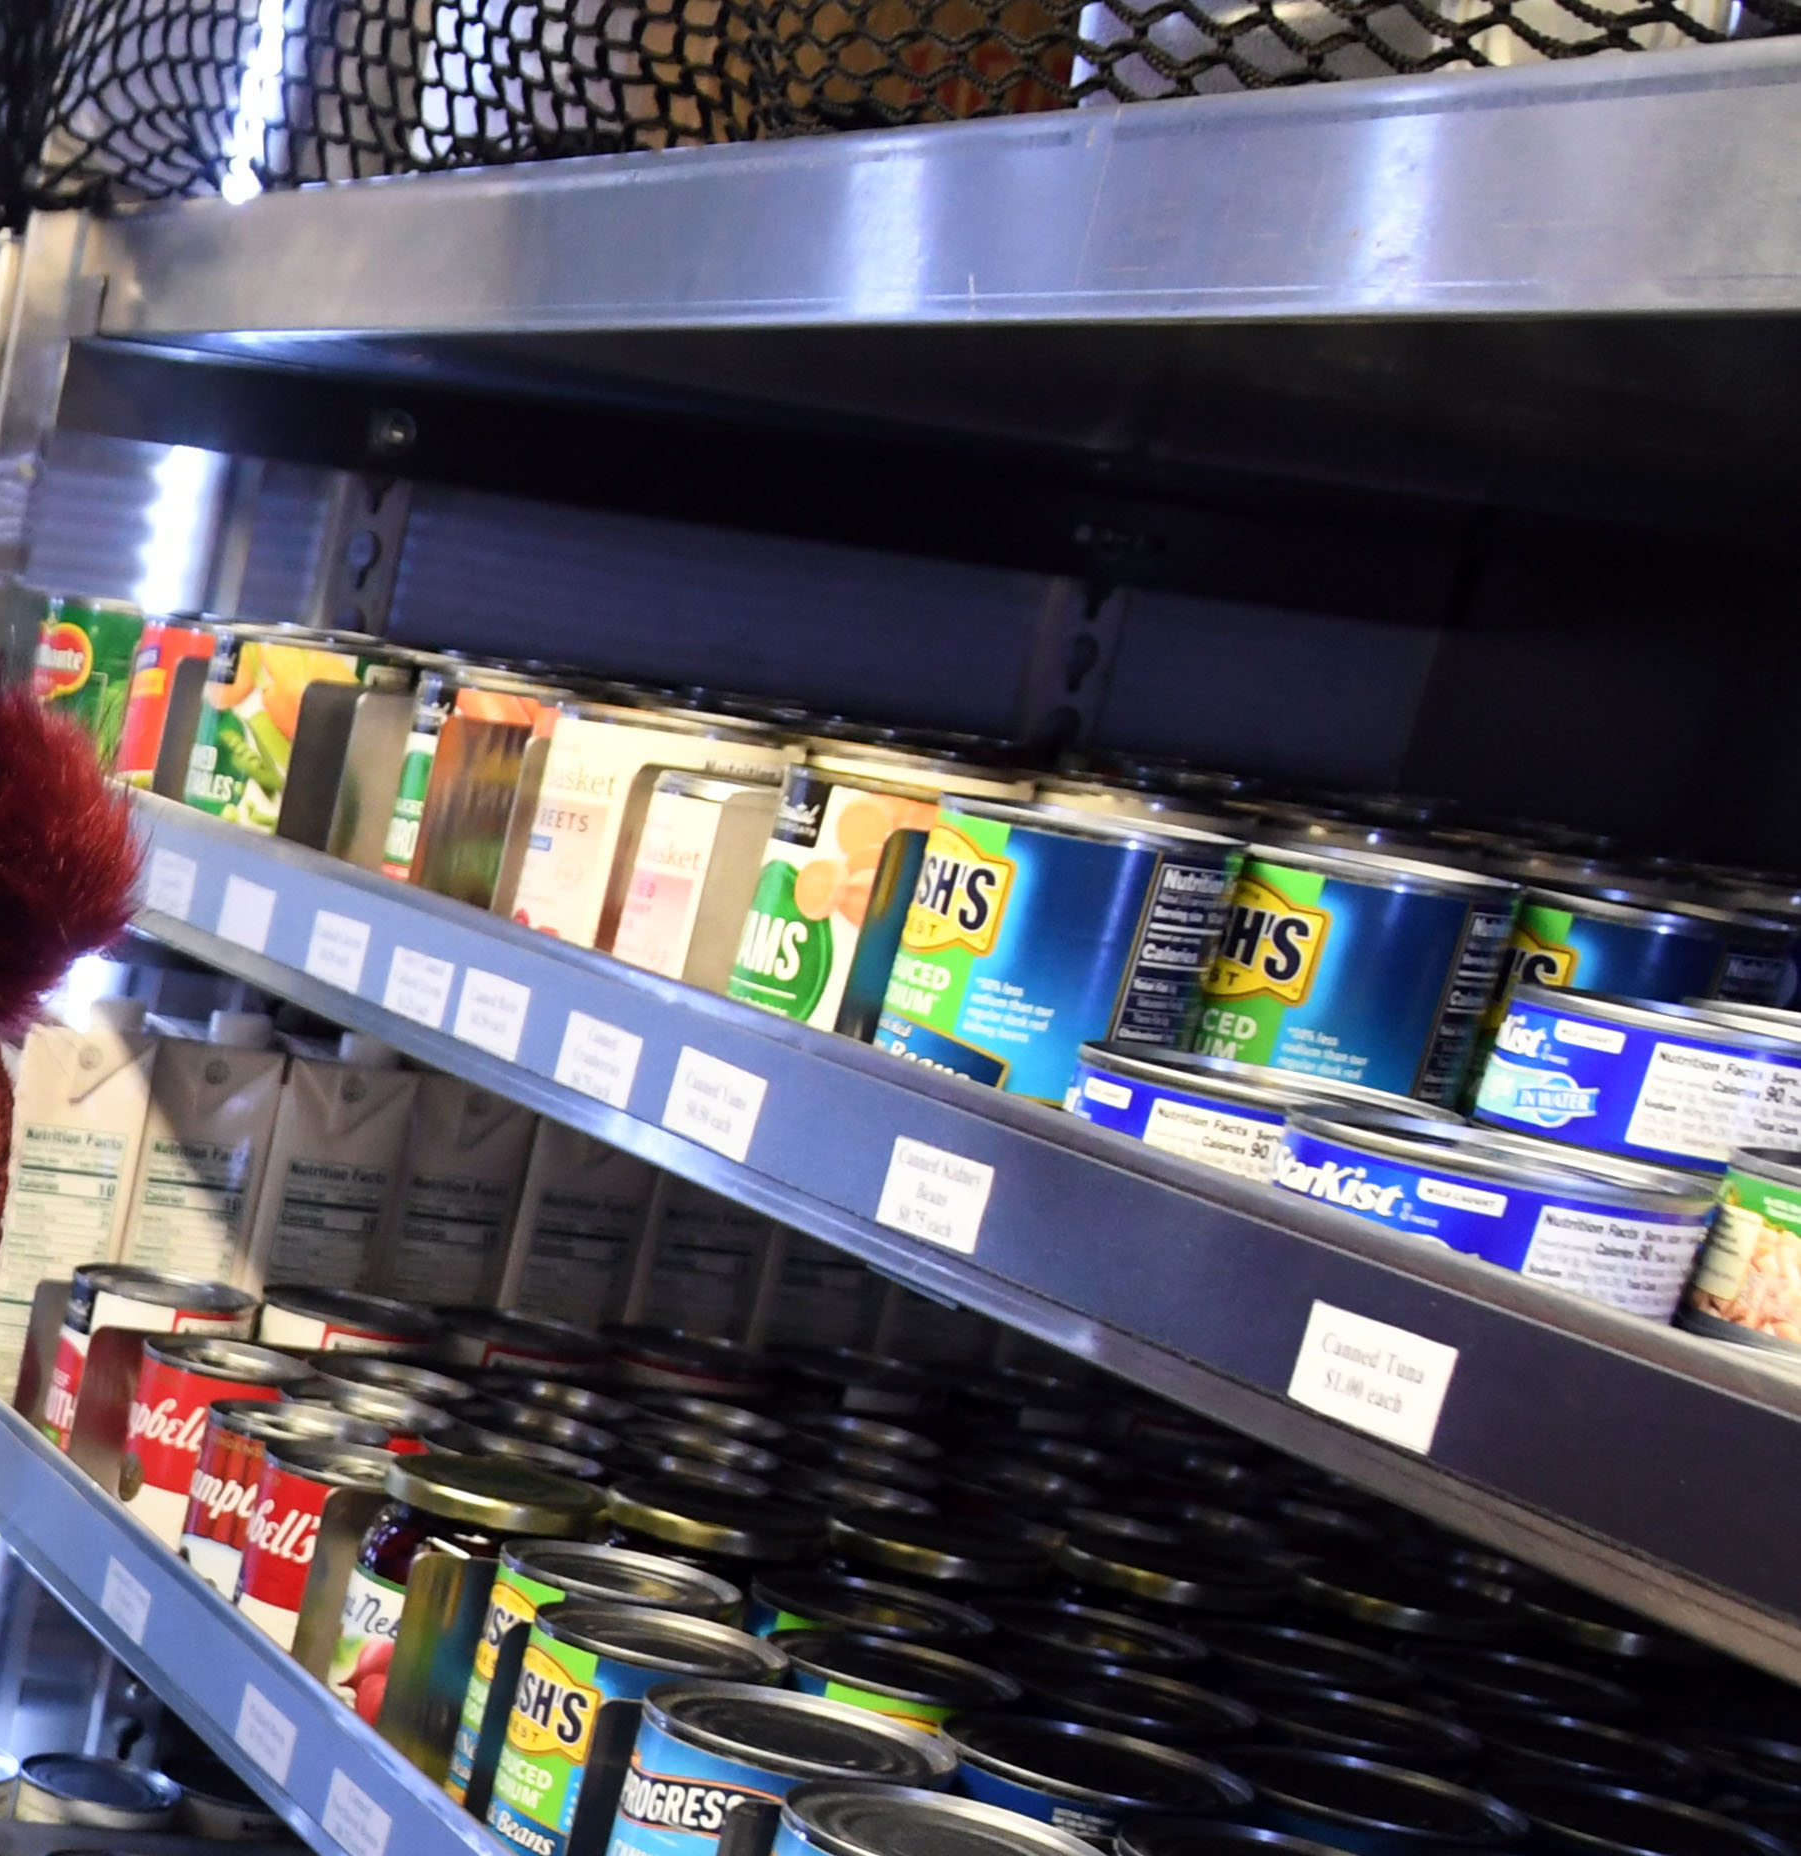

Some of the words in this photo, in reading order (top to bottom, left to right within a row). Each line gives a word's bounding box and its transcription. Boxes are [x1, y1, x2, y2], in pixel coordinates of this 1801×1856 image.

[1320, 1331, 1383, 1370] Canned
[1385, 1352, 1425, 1385] Tuna
[1366, 1387, 1403, 1415] each
